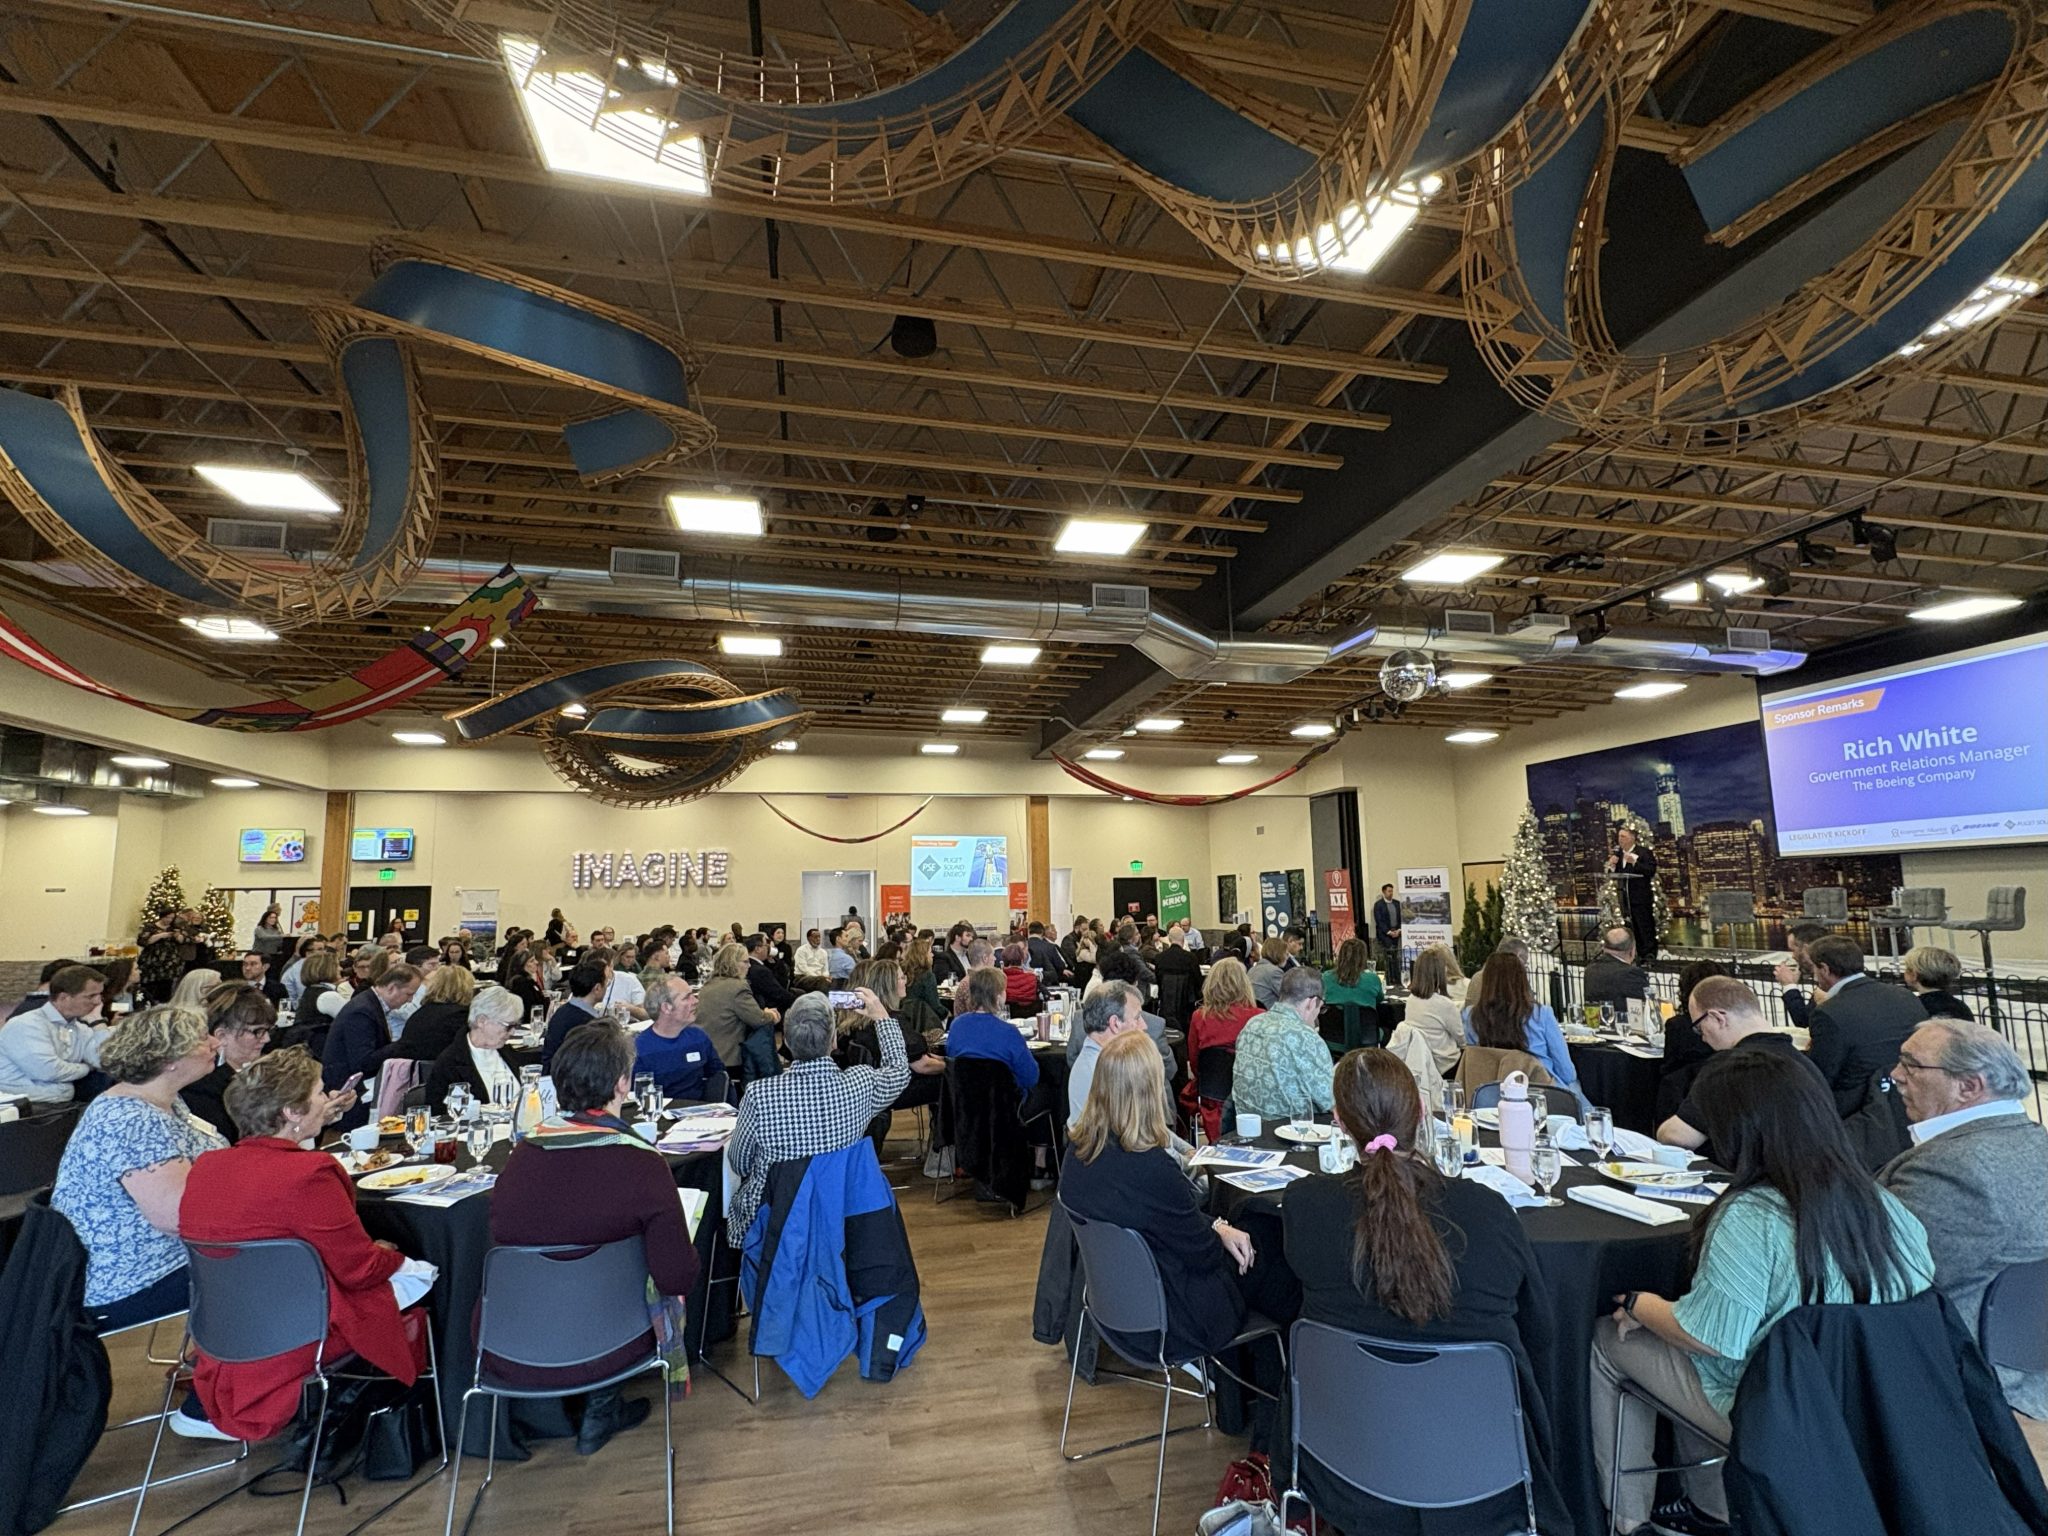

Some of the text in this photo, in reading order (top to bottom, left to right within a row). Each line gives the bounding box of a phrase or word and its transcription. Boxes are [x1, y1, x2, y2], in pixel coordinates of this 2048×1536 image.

[1774, 699, 1865, 724] Sponsor Remarks
[1843, 726, 1978, 761] Rich White
[1809, 745, 2031, 783] Government Relations Manager
[1852, 768, 1976, 791] The Boeing Company
[1788, 828, 1867, 841] LEGISLATIVE KICKOFF
[572, 849, 728, 888] IMAGINE
[922, 862, 936, 872] PSE
[1404, 875, 1441, 885] Herald
